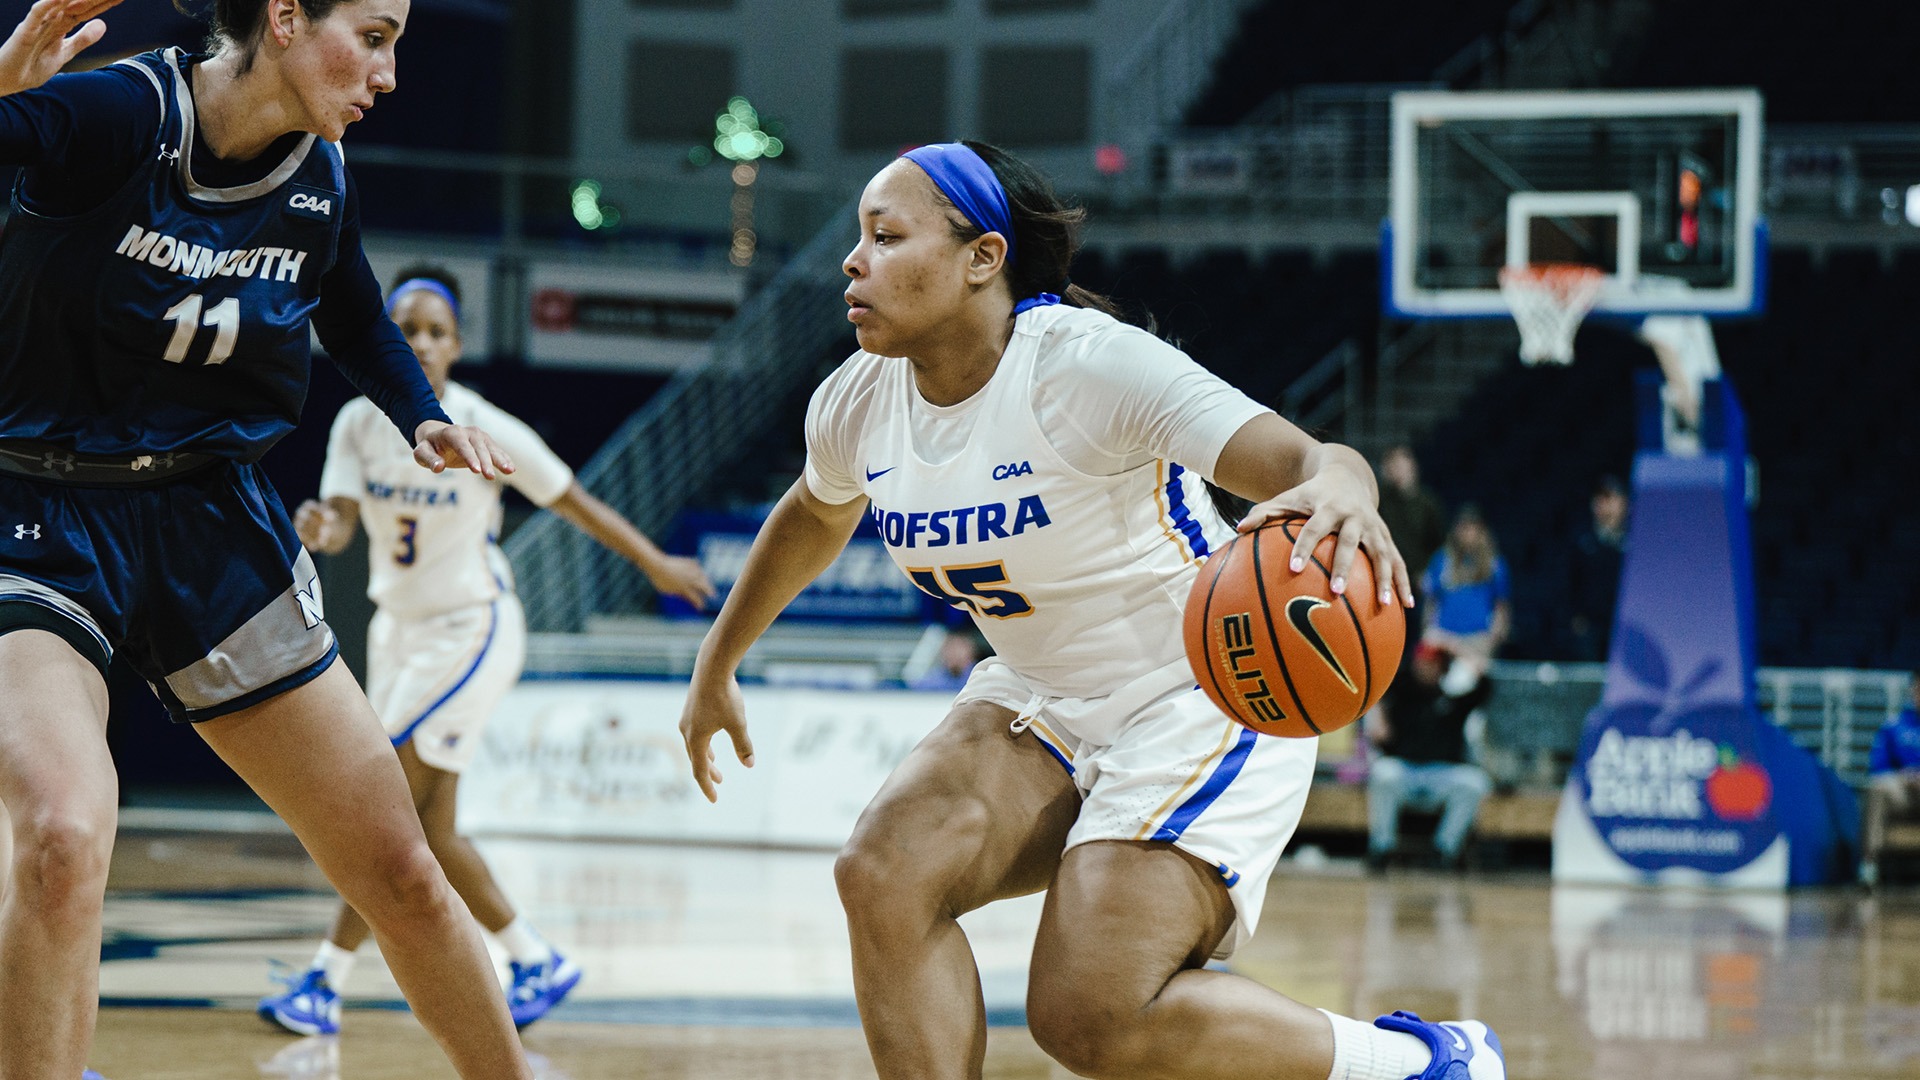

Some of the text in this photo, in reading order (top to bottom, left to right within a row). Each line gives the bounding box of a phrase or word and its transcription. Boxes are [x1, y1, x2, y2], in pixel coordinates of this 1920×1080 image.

[289, 193, 331, 216] CAA
[115, 223, 308, 284] MONMOUTH
[162, 293, 240, 366] 11
[992, 460, 1034, 481] CAA
[393, 515, 418, 567] 3
[1222, 611, 1288, 723] ELITE
[1587, 728, 1718, 781] Apple
[1591, 776, 1702, 819] Bank
